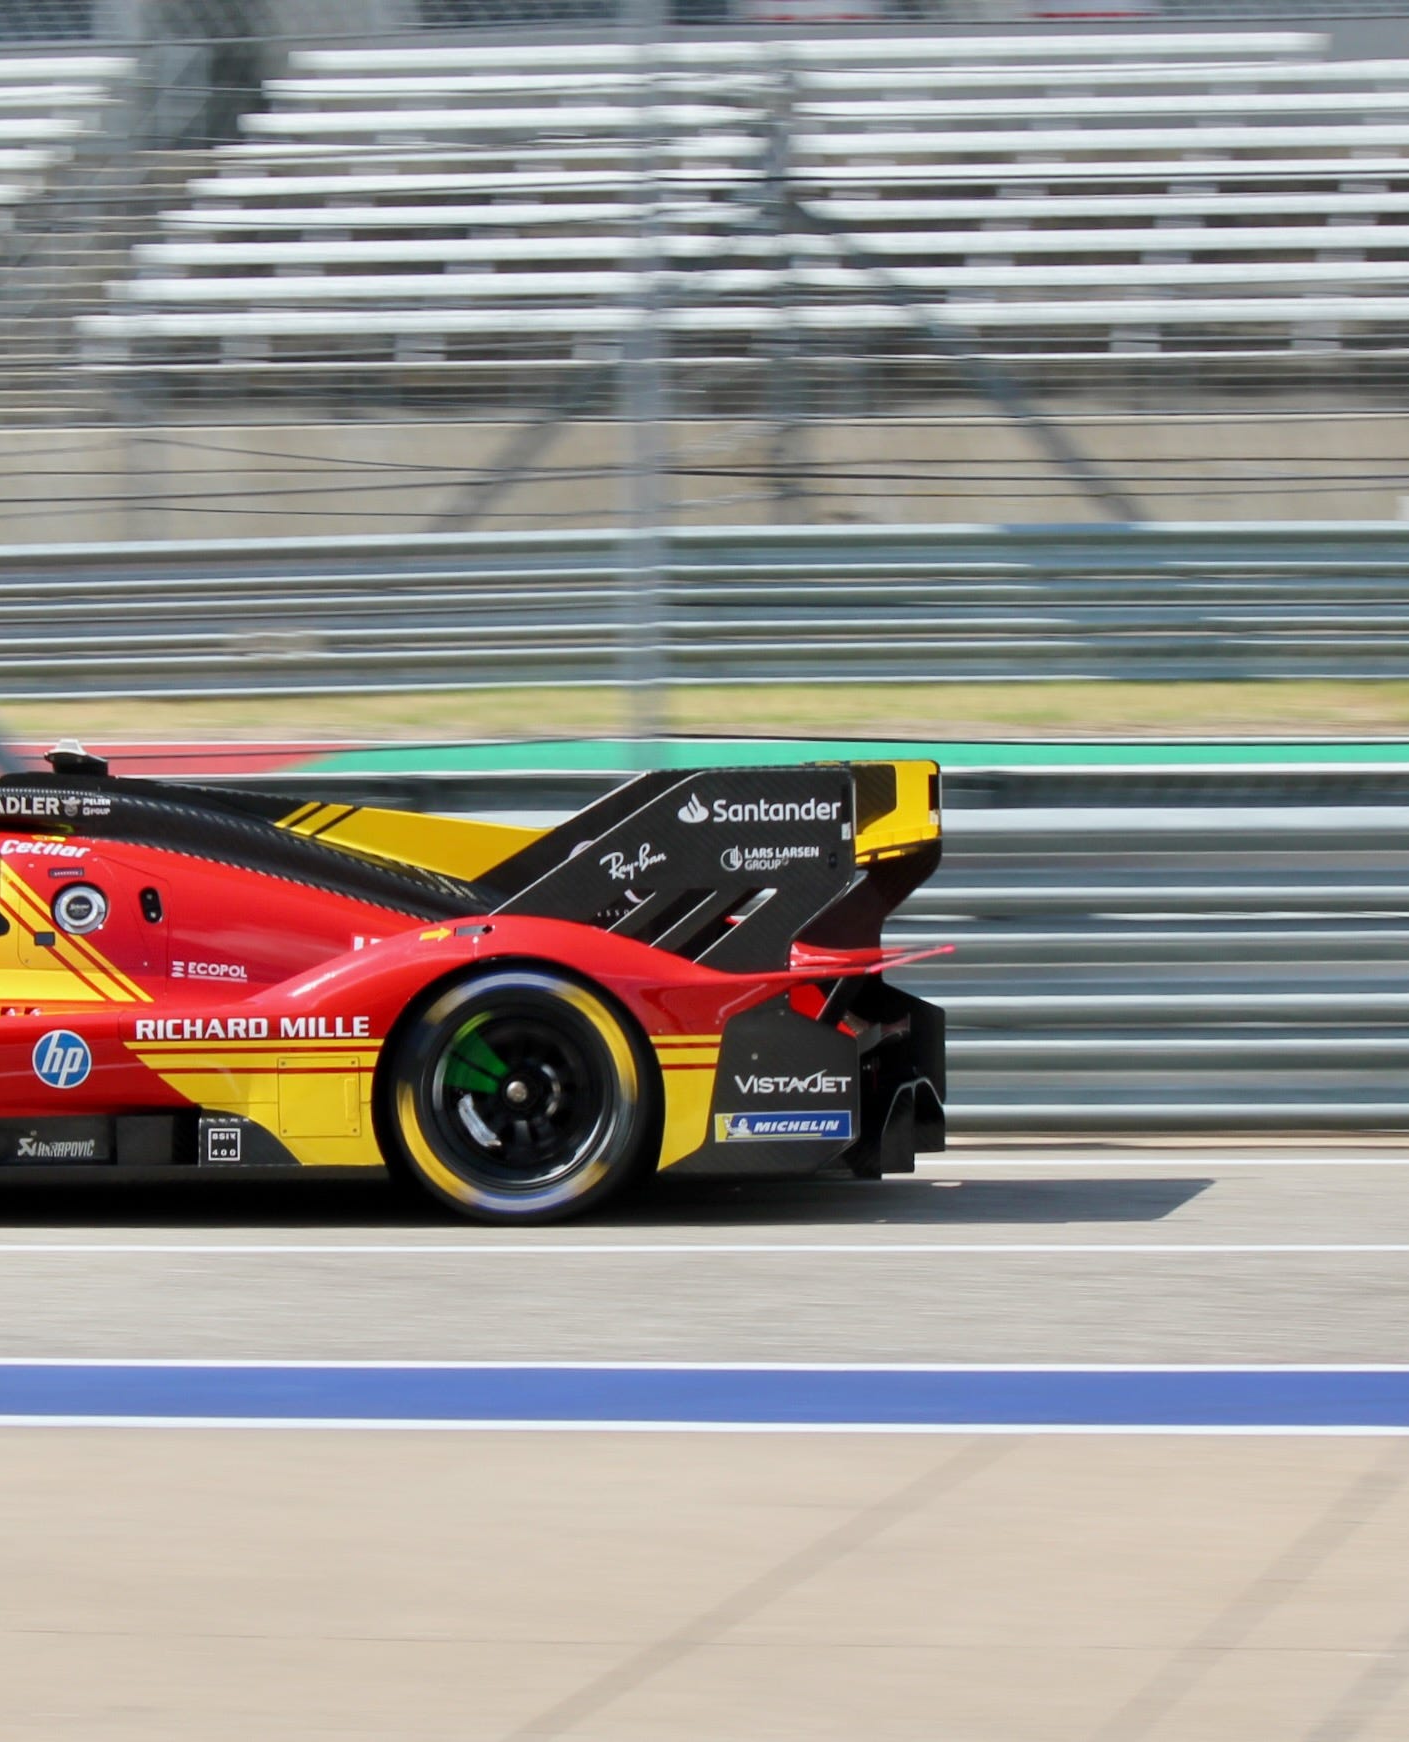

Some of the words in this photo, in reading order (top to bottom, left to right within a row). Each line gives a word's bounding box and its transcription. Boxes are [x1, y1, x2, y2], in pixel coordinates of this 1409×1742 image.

[712, 798, 841, 823] Santander
[599, 842, 667, 880] Ray-Ban
[744, 847, 773, 859] LARS
[775, 846, 819, 859] LARSEN
[744, 859, 782, 871] GROUP
[187, 961, 248, 978] ECOPOL
[136, 1017, 268, 1041] RICHARD
[279, 1016, 370, 1039] MILLE
[41, 1032, 85, 1088] hp
[753, 1119, 840, 1133] MICHELIN
[211, 1148, 237, 1157] 400
